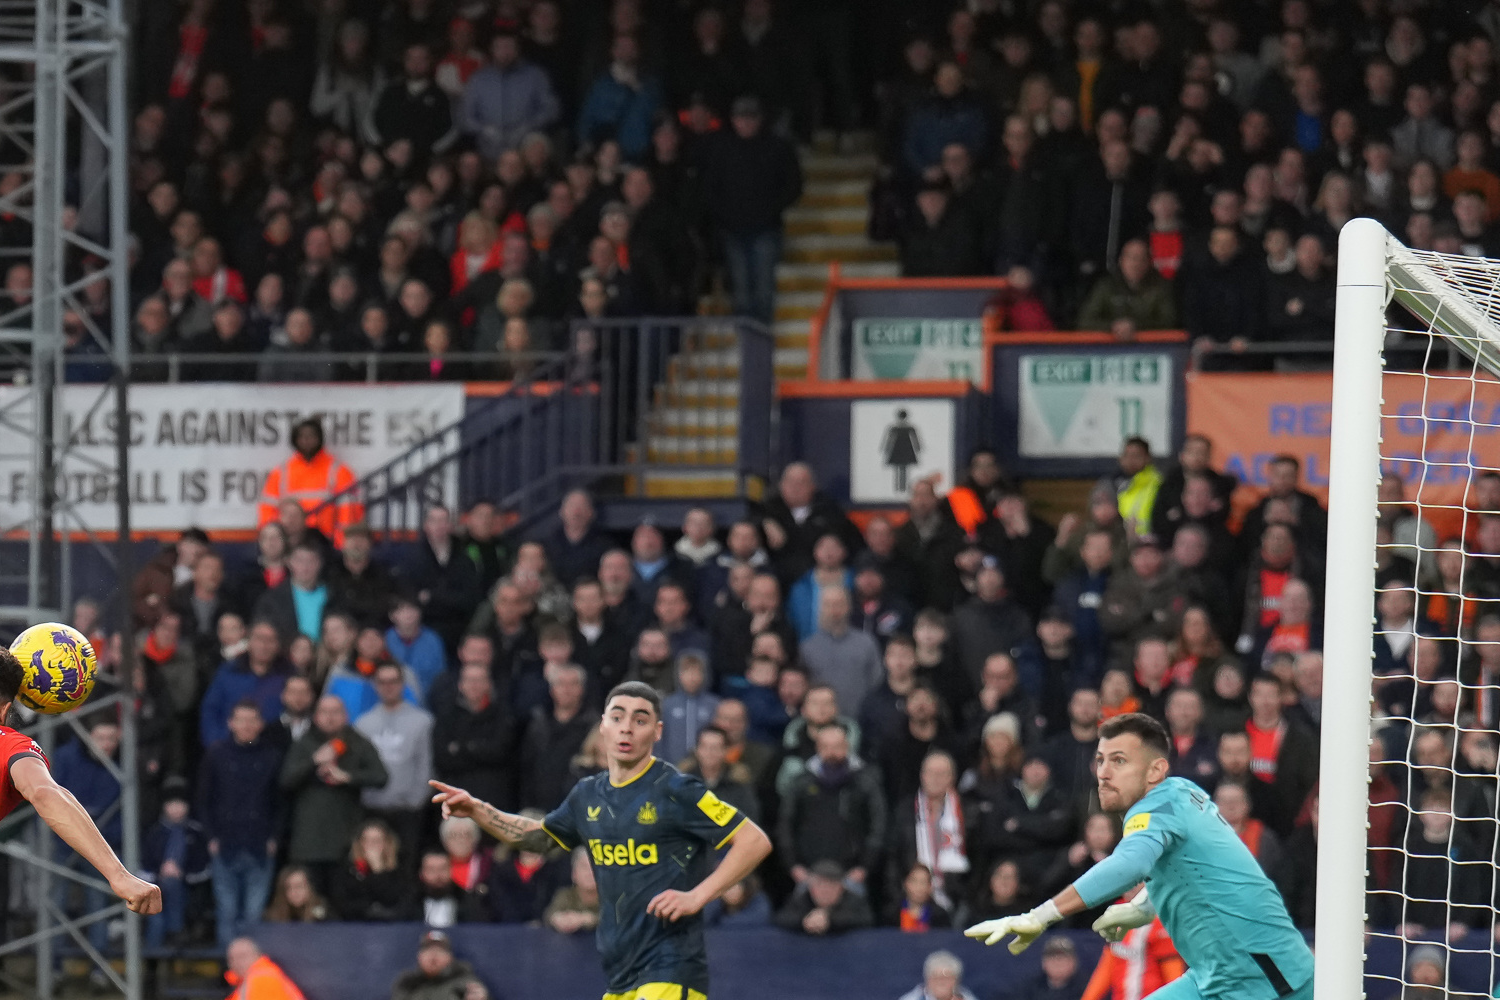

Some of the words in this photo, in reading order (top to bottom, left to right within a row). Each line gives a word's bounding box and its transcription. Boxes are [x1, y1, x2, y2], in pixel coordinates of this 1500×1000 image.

[11, 470, 169, 504] FOTBLL
[223, 470, 266, 503] FO
[603, 837, 659, 867] sela
